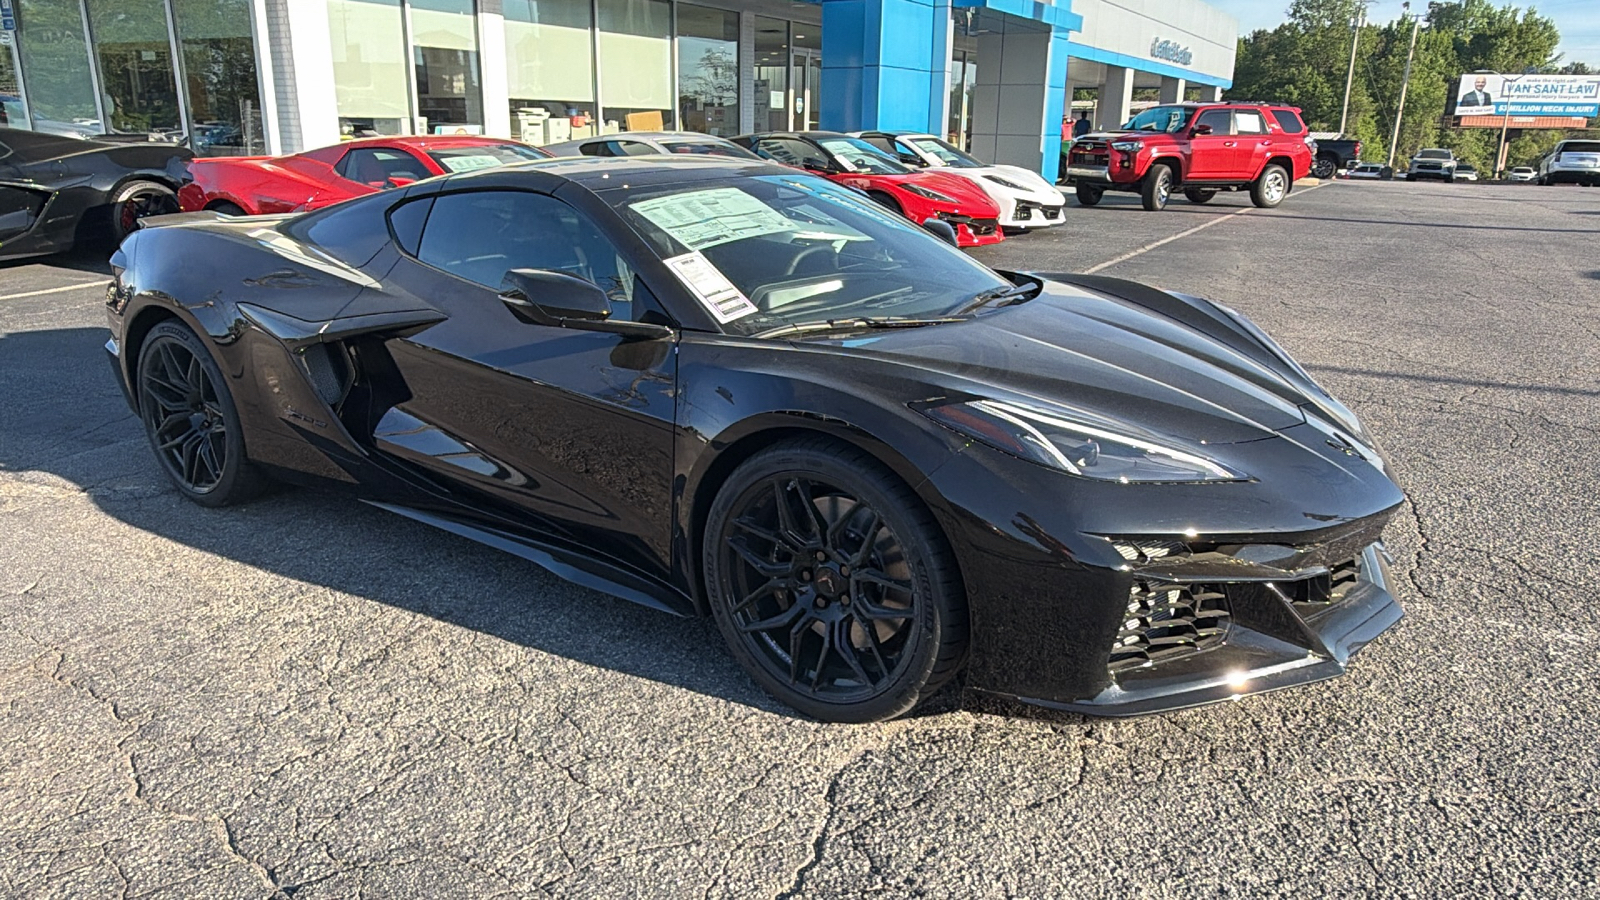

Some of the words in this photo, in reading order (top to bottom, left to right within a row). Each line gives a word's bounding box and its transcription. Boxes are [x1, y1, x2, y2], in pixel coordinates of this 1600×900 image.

[1507, 84, 1531, 93] VAN
[1534, 84, 1566, 94] SANT
[1568, 84, 1595, 94] LAW
